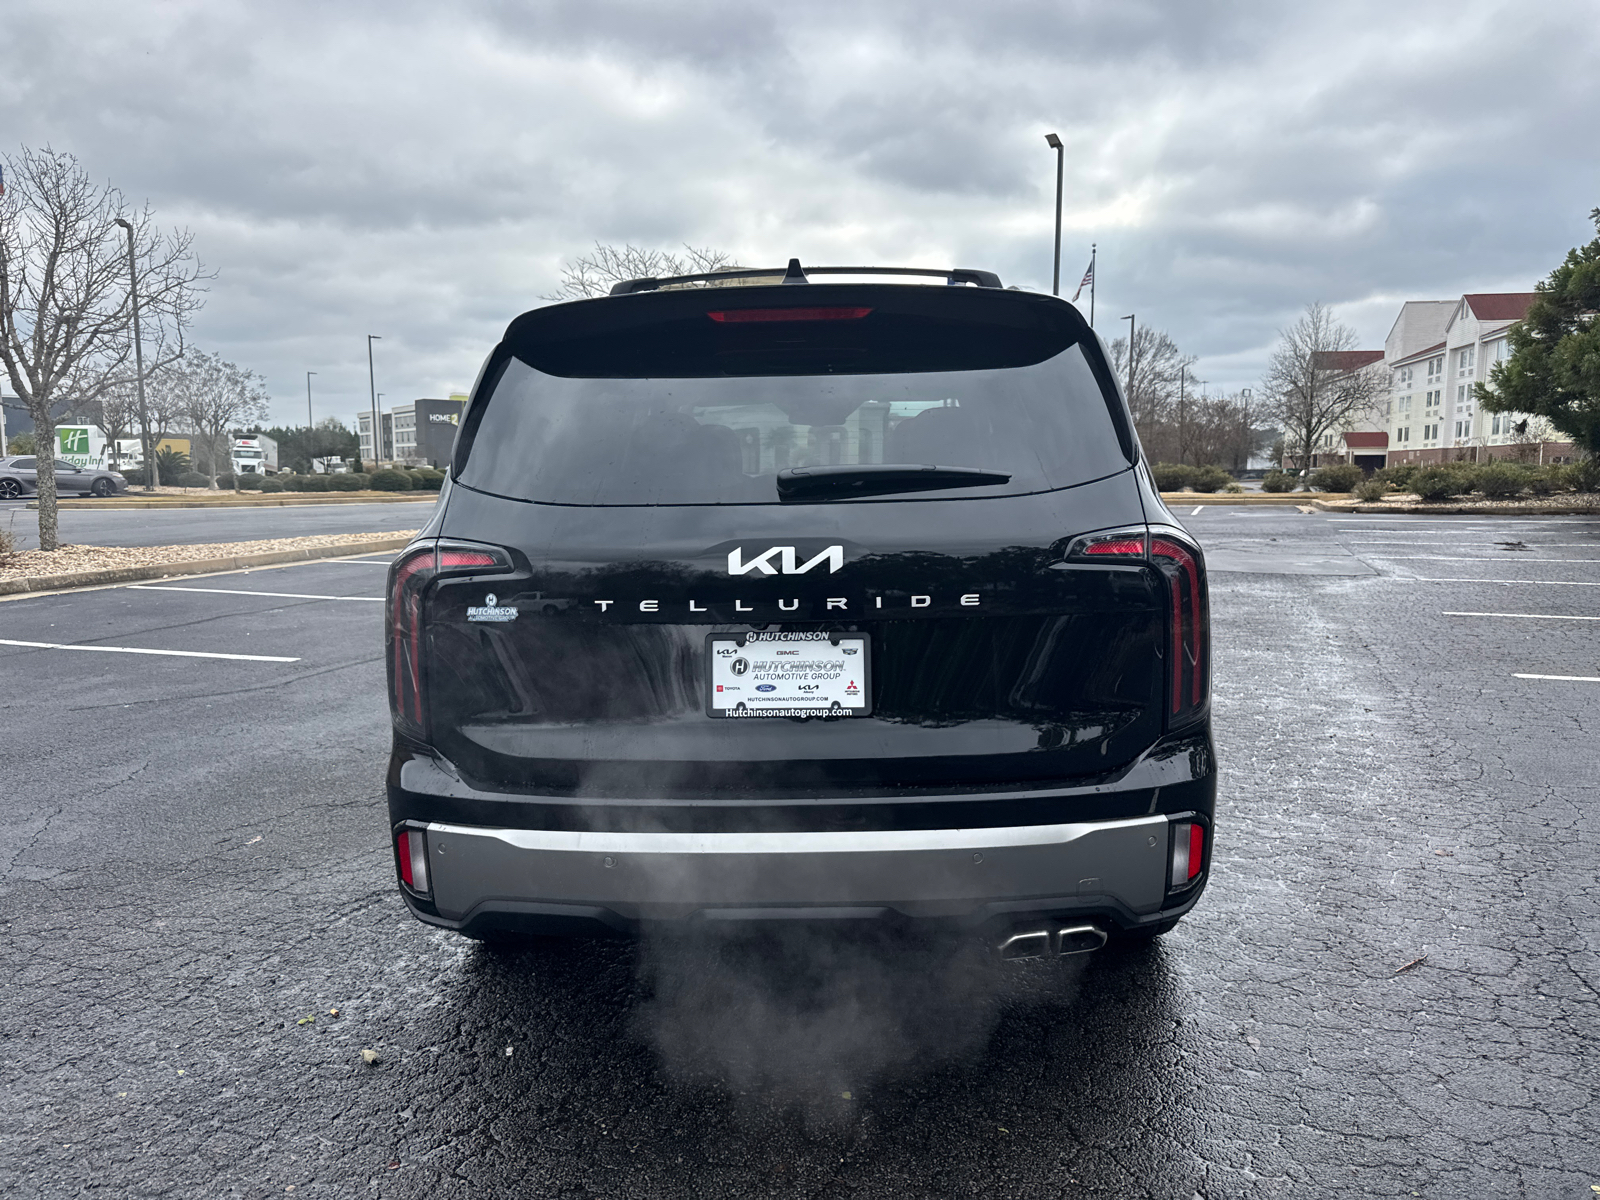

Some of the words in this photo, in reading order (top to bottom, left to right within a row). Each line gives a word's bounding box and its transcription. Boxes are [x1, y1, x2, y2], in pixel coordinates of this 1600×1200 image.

[451, 415, 458, 426] 2
[89, 455, 103, 465] Inn
[727, 545, 844, 575] KIA
[595, 594, 981, 613] TELLURIDE
[467, 607, 518, 616] HUTCHINSON
[759, 632, 829, 641] HUTCHINSON
[752, 660, 845, 673] HUTCHINSON
[753, 673, 809, 681] AUTOMOTIVE
[725, 708, 852, 718] Hutchinsonautogroup.com
